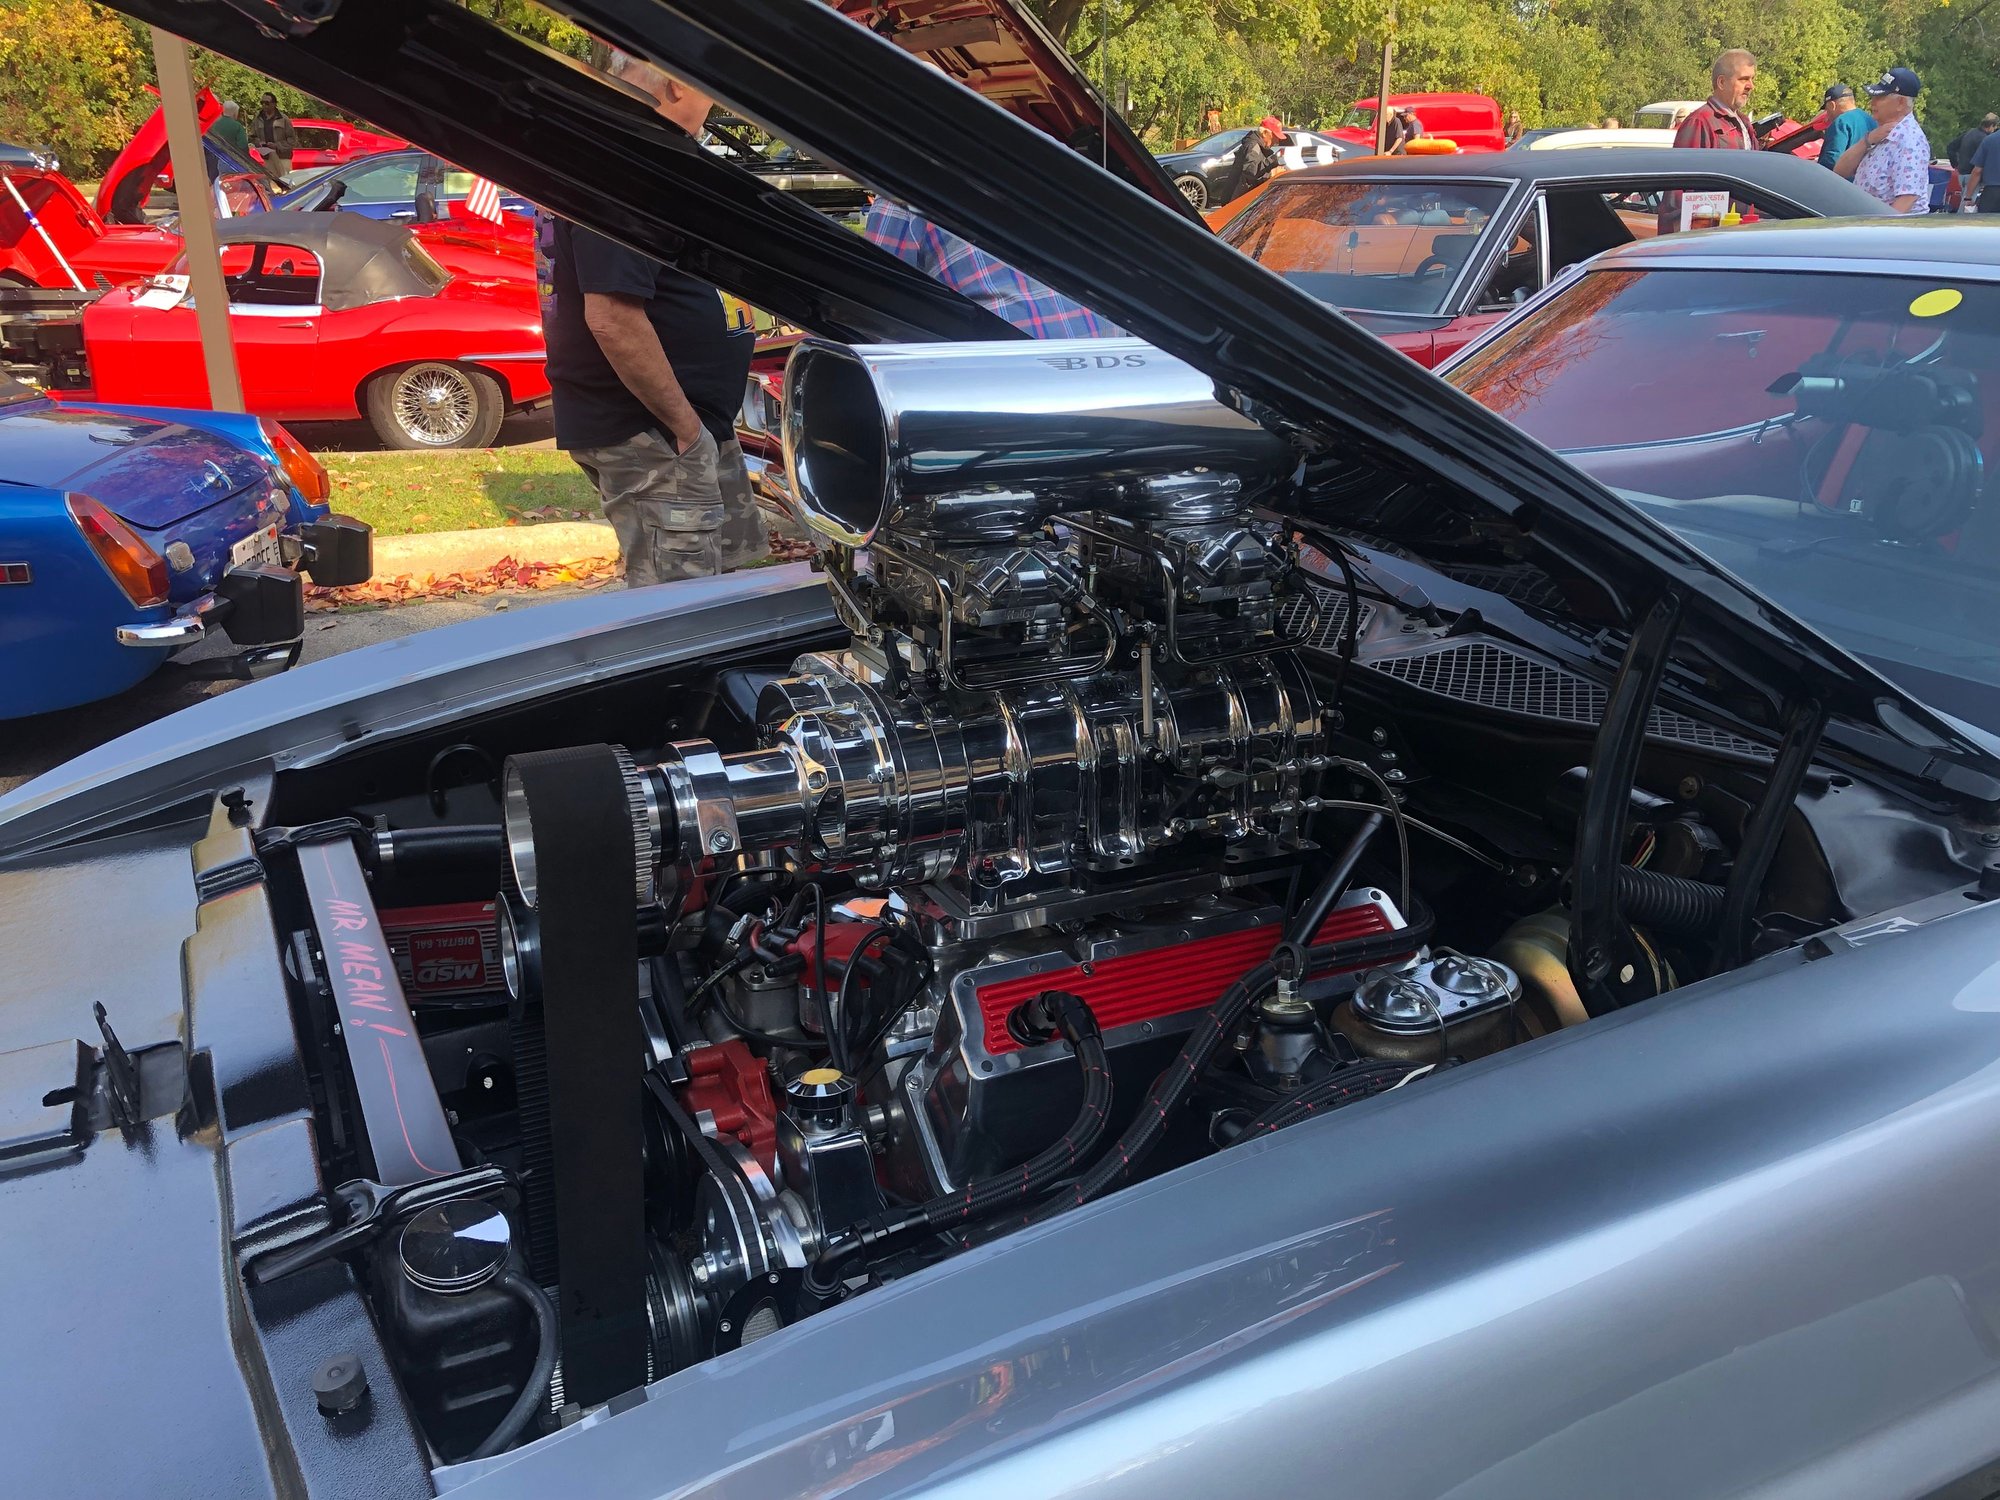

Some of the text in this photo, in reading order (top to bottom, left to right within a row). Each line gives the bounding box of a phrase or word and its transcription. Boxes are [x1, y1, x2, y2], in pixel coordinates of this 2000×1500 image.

[1037, 355, 1146, 370] BDS
[325, 899, 368, 936] MR.
[435, 936, 475, 947] DIGITAL
[417, 963, 479, 983] MSD
